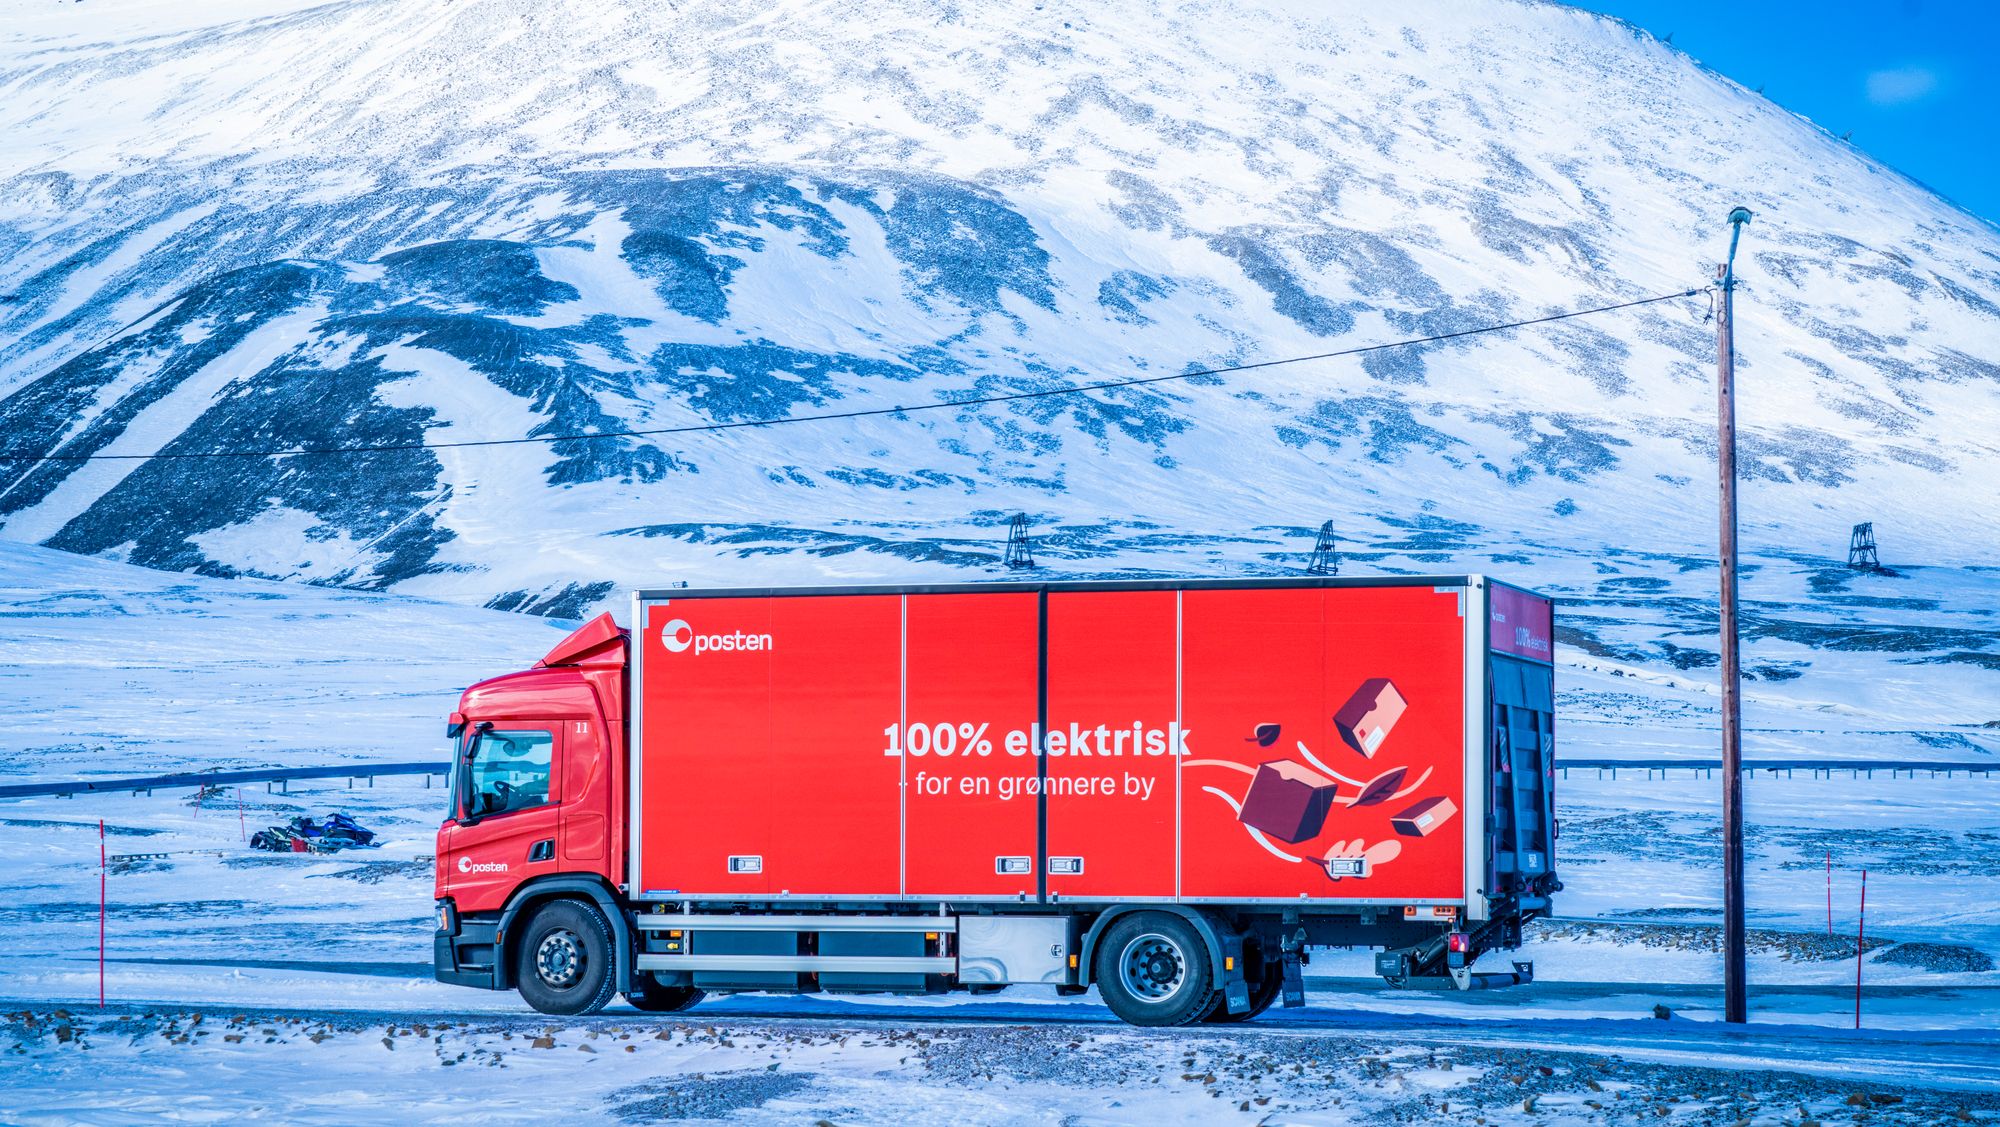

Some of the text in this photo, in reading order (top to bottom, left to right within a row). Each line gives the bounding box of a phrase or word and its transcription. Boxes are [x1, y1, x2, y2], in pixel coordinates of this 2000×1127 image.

[694, 630, 773, 656] posten
[575, 721, 588, 734] 11
[883, 720, 1192, 757] 100% elektrisk
[915, 771, 953, 795] for
[959, 776, 990, 795] en
[998, 776, 1116, 801] grønnere
[1124, 771, 1156, 801] by
[472, 861, 508, 875] posten
